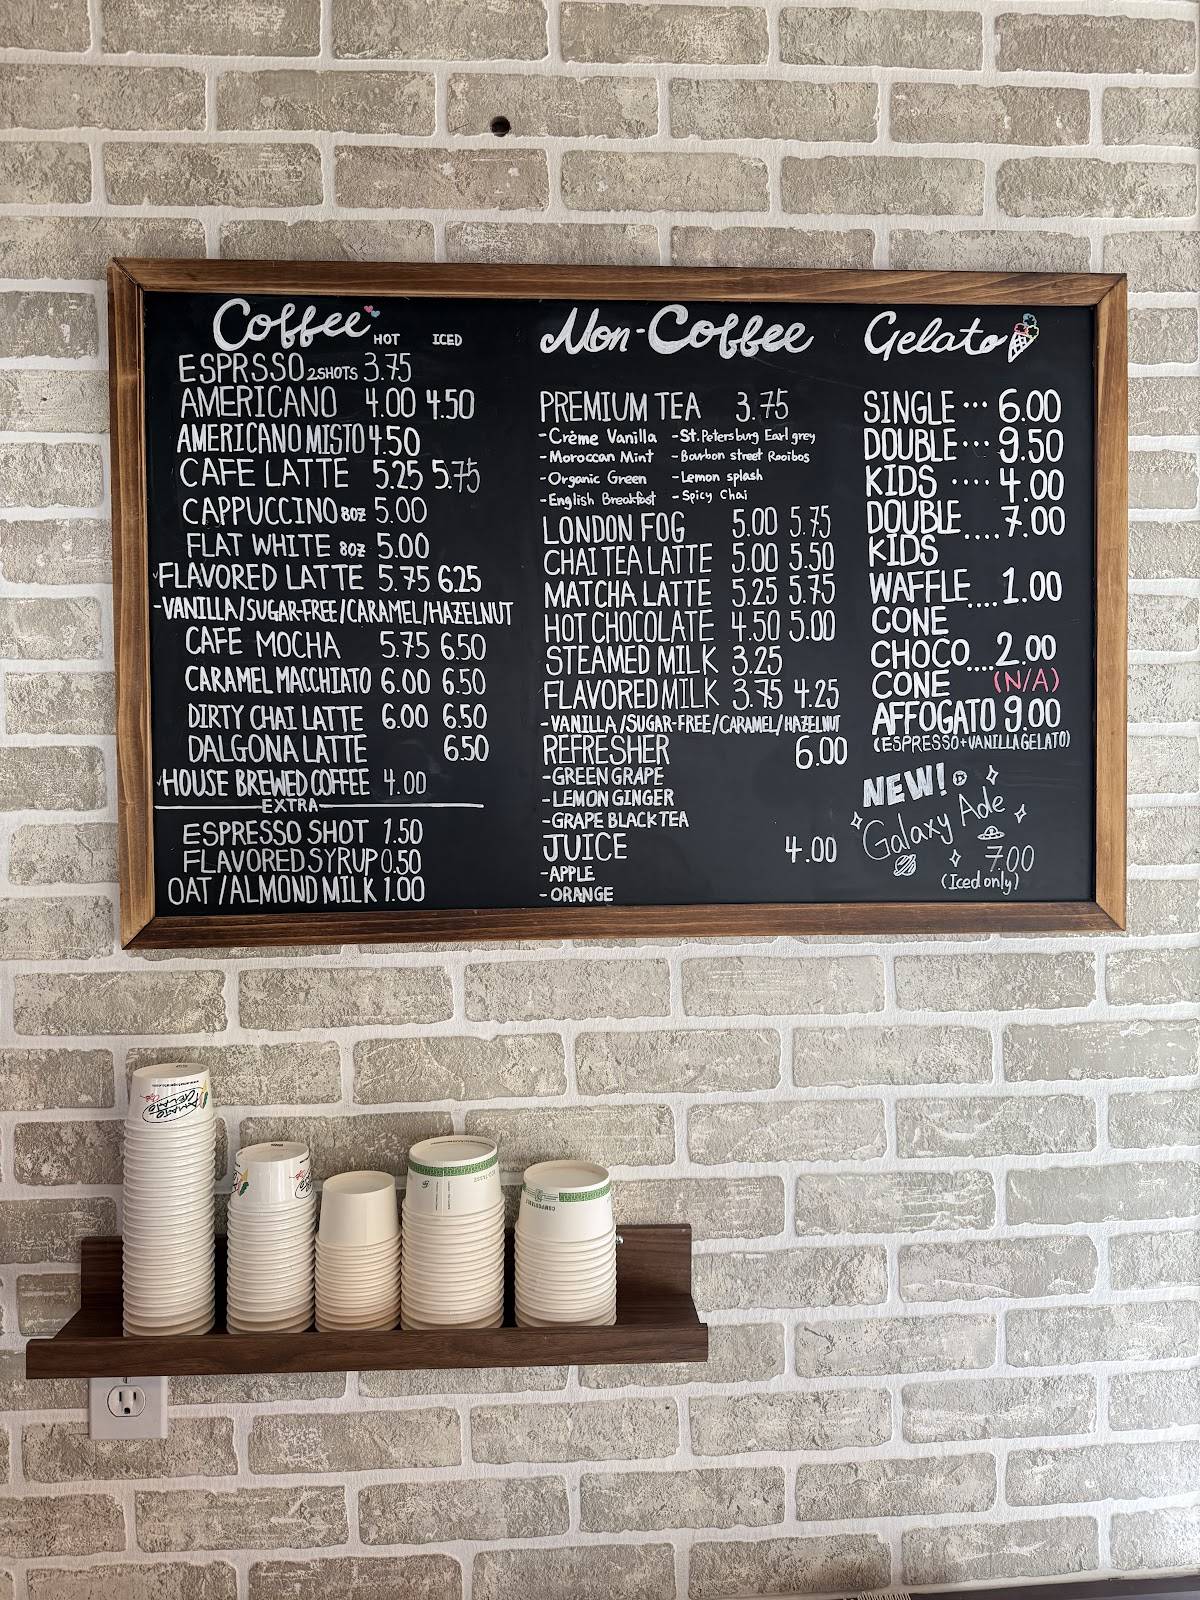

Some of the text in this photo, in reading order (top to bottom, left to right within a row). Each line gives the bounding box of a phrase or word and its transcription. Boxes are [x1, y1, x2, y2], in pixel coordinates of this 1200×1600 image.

[213, 298, 371, 351] Coffee
[374, 334, 462, 346] HOT ICED
[540, 304, 814, 359] Non-Coffee
[864, 311, 1008, 361] Gelato
[179, 353, 304, 383] ESPRSSO
[364, 352, 411, 382] 3.75
[181, 385, 474, 419] AMERICANO 4.00 4.50
[541, 388, 788, 423] PREMIUM TEA 3.75
[864, 388, 1061, 425] SINGLE 6.00
[177, 422, 420, 456] AMERICANO MISTO 4.50
[607, 428, 657, 444] Vanilla
[765, 427, 788, 441] Earl
[791, 433, 815, 445] grey
[864, 426, 1063, 463] DOUBLE 9.50
[620, 449, 654, 463] Mint
[730, 448, 763, 461] street
[768, 450, 810, 463] Rooibos
[180, 458, 480, 493] CAFE LATTE 5.25 5.75
[607, 470, 647, 484] Green
[727, 469, 763, 487] splash
[866, 464, 1064, 503] KIDS 4.00
[602, 491, 656, 505] Breakfast
[720, 488, 747, 500] Chai
[183, 496, 338, 525] CAPPUCCINO
[375, 496, 427, 523] 5.00
[543, 505, 830, 544] LONDON FOG 5.00 5.75
[867, 499, 1065, 537] DOUBLE 7.00
[187, 533, 243, 558] FLAT
[252, 533, 330, 557] WHITE
[377, 532, 429, 559] 5.00
[544, 542, 834, 576] CHAI TEA LATTE 5.00 5.50
[869, 534, 938, 567] KIDS
[159, 562, 481, 593] FLAVORED LATTE 5.75 6.25
[545, 573, 835, 608] MATCHA LATTE 5.25 5.75
[869, 567, 1062, 604] WAFFLE 1.00
[545, 609, 835, 643] HOT CHOCOLATE 4.50 5.00
[872, 606, 949, 637] CONE
[186, 626, 486, 660] CAFE MOCHA 5.75 6.50
[871, 632, 1056, 669] CHOCO 2.00
[546, 644, 782, 676] STEAMED MILK 3.25
[185, 666, 486, 695] CARAMEL MACCHIATO 6.00 6.50
[544, 677, 839, 710] FLAVORED MILK 3.75 4.25
[872, 667, 1059, 699] CONE (N/A)
[188, 703, 487, 732] DIRTY CHAI LATTE 6.00 6.50
[872, 695, 1060, 735] AFFOGATO 9.00
[189, 734, 489, 763] DALGONA LATTE 6.50
[543, 734, 847, 769] REFRESHER 6.00
[163, 768, 426, 797] HOUSE BREWED COFFEE 4.00
[611, 767, 664, 785] GRAPE
[863, 762, 947, 807] NEW!
[262, 798, 318, 813] EXTRA
[612, 789, 674, 806] GINGER
[183, 818, 423, 846] ESPRESSO SHOT 1.50
[608, 811, 657, 828] BLACK
[659, 811, 689, 827] TEA
[863, 786, 1005, 860] Galaxy Ade
[184, 847, 421, 876] FLAVORED SYRUP 0.50
[543, 832, 837, 863] JUICE 4.00
[985, 845, 1034, 872] 7.00
[168, 877, 212, 905] OAT
[322, 876, 377, 904] MILK
[384, 876, 424, 902] 1.00
[941, 870, 1019, 895] (Iced only)
